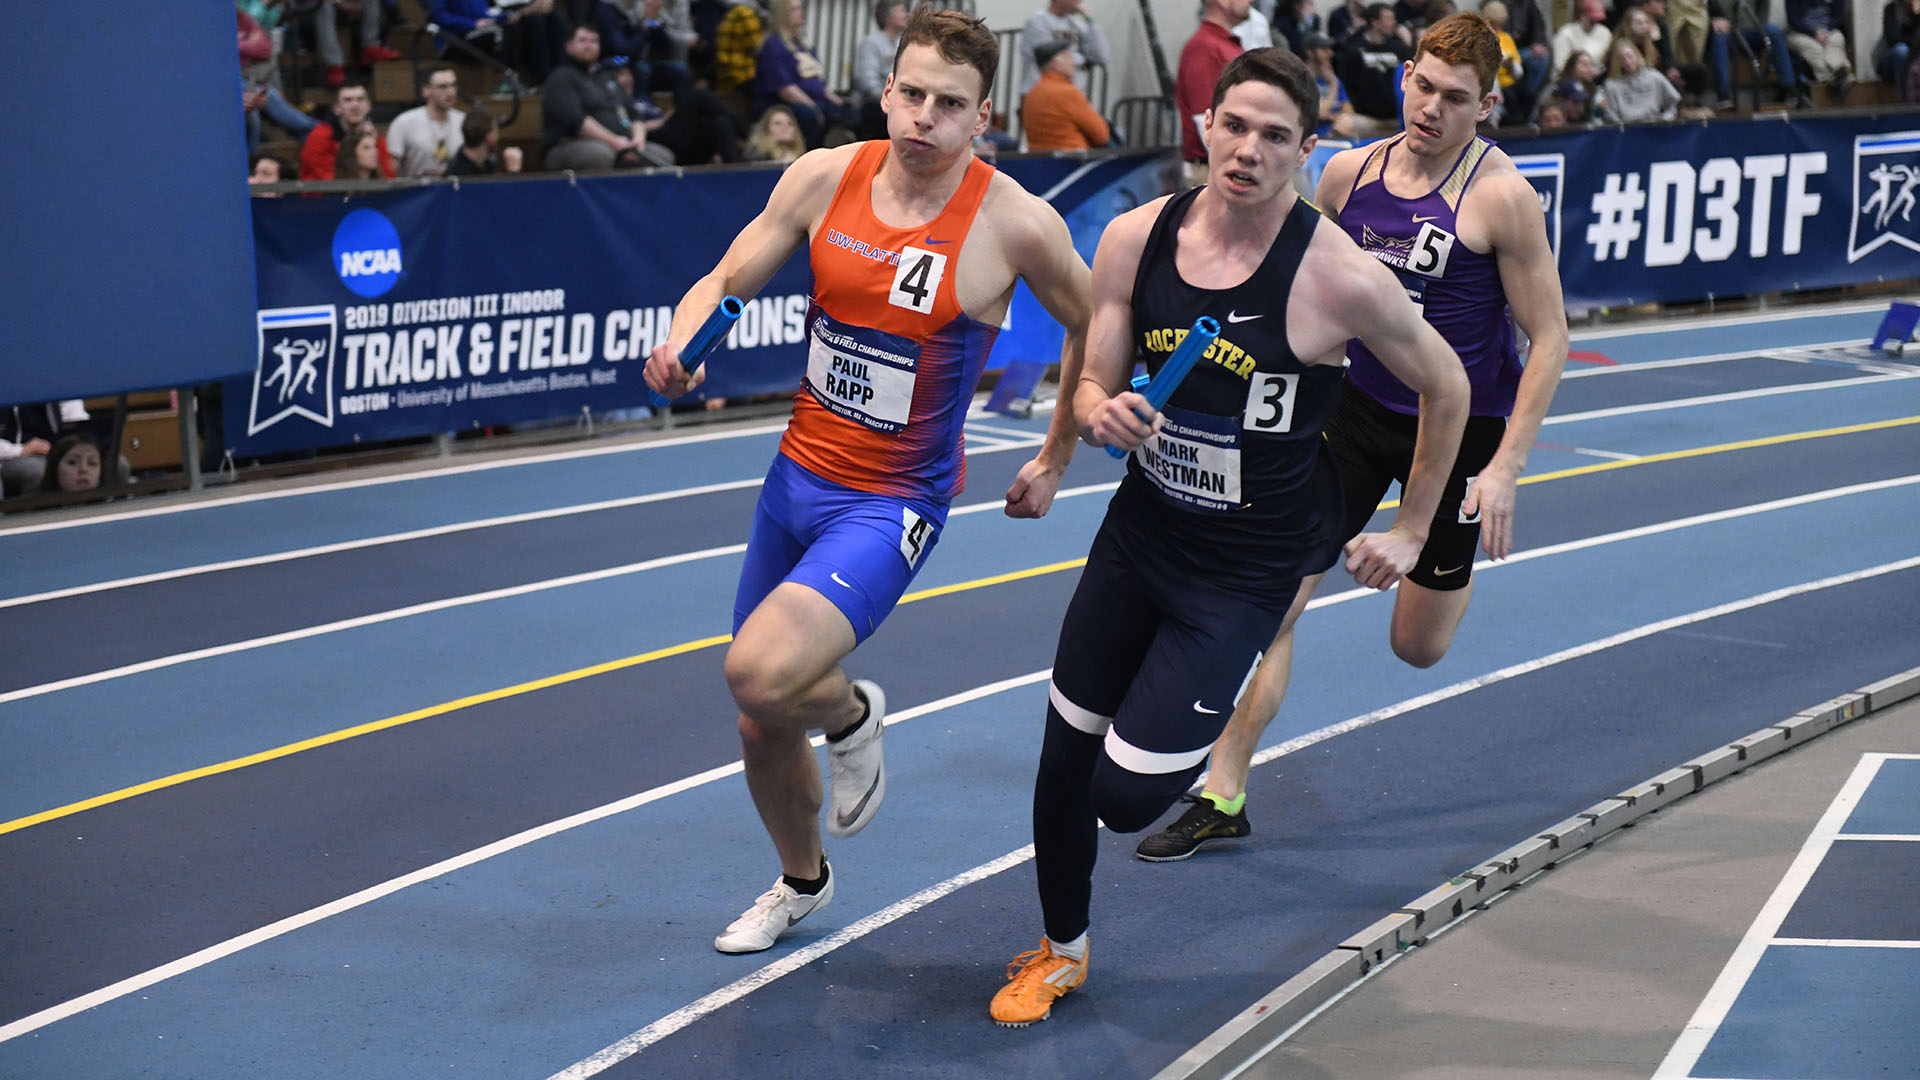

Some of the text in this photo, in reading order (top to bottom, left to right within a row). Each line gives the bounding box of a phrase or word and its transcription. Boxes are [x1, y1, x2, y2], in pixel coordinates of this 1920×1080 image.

[1586, 151, 1828, 267] #D3TF
[341, 249, 402, 277] NCAA
[1415, 229, 1446, 272] 5
[899, 254, 934, 307] 4
[345, 288, 565, 330] 2019 DIVISION III INDOOR
[343, 325, 464, 390] TRACK
[468, 322, 494, 376] &
[499, 312, 595, 374] FIELD
[832, 355, 870, 382] PAUL
[839, 337, 858, 351] FIELD
[857, 343, 915, 367] CHAMPIONSHIPS
[1144, 328, 1256, 381] ROCHSTER
[340, 393, 389, 415] BOSTON
[397, 384, 453, 406] University
[455, 382, 468, 400] of
[470, 375, 547, 399] Massachusetts
[825, 372, 874, 406] RAPP
[1255, 377, 1287, 428] 3
[1158, 436, 1199, 463] MARK
[1179, 425, 1236, 443] CHAMPIONSHIPS
[1143, 445, 1225, 494] WESTMAN
[907, 518, 927, 562] 4
